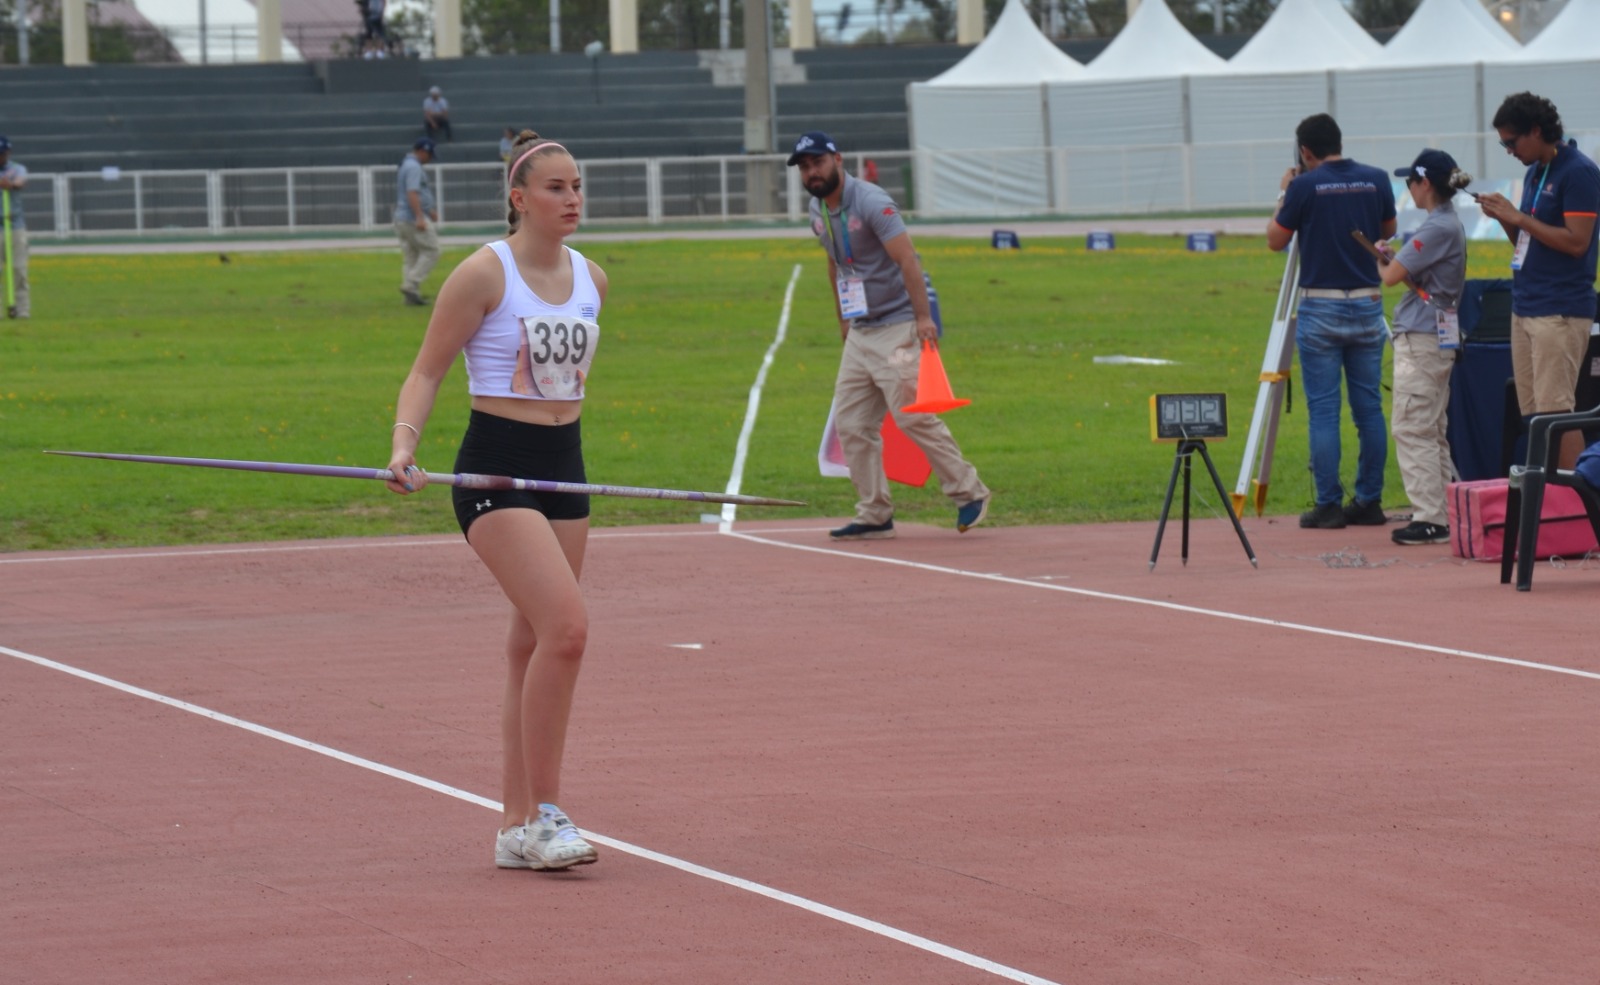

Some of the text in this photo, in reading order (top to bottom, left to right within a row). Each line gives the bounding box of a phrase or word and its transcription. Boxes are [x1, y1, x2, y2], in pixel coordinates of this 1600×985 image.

[1316, 181, 1376, 190] DEPORTE VIRTUAL
[533, 322, 588, 365] 339
[1164, 400, 1217, 422] 032
